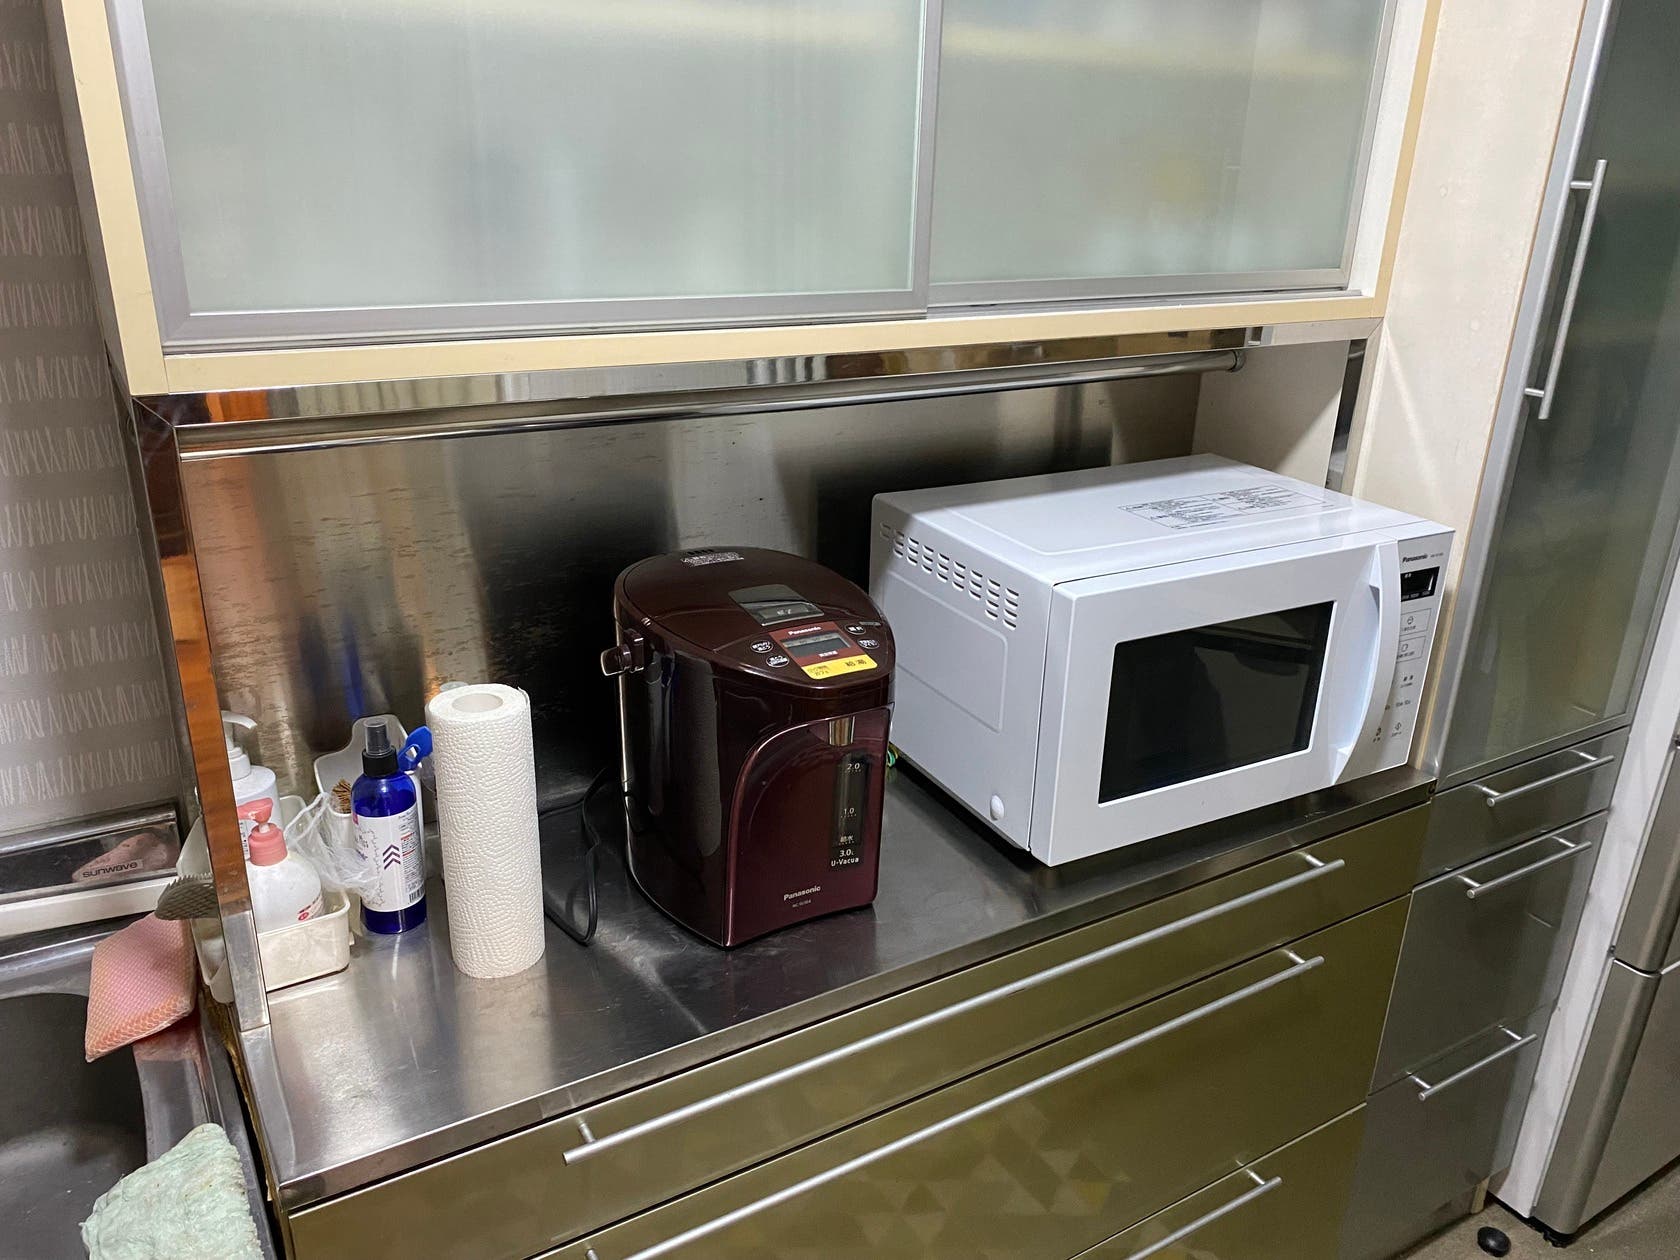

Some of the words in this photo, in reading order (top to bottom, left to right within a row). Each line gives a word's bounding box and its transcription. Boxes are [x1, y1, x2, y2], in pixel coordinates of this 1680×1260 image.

[1402, 553, 1428, 563] Panasonic
[788, 626, 822, 636] Panasonic
[847, 762, 860, 771] 2.0
[843, 807, 855, 815] 1.0
[831, 857, 860, 867] U-Vacua
[82, 861, 138, 878] sunwave
[783, 885, 821, 901] Panasonic
